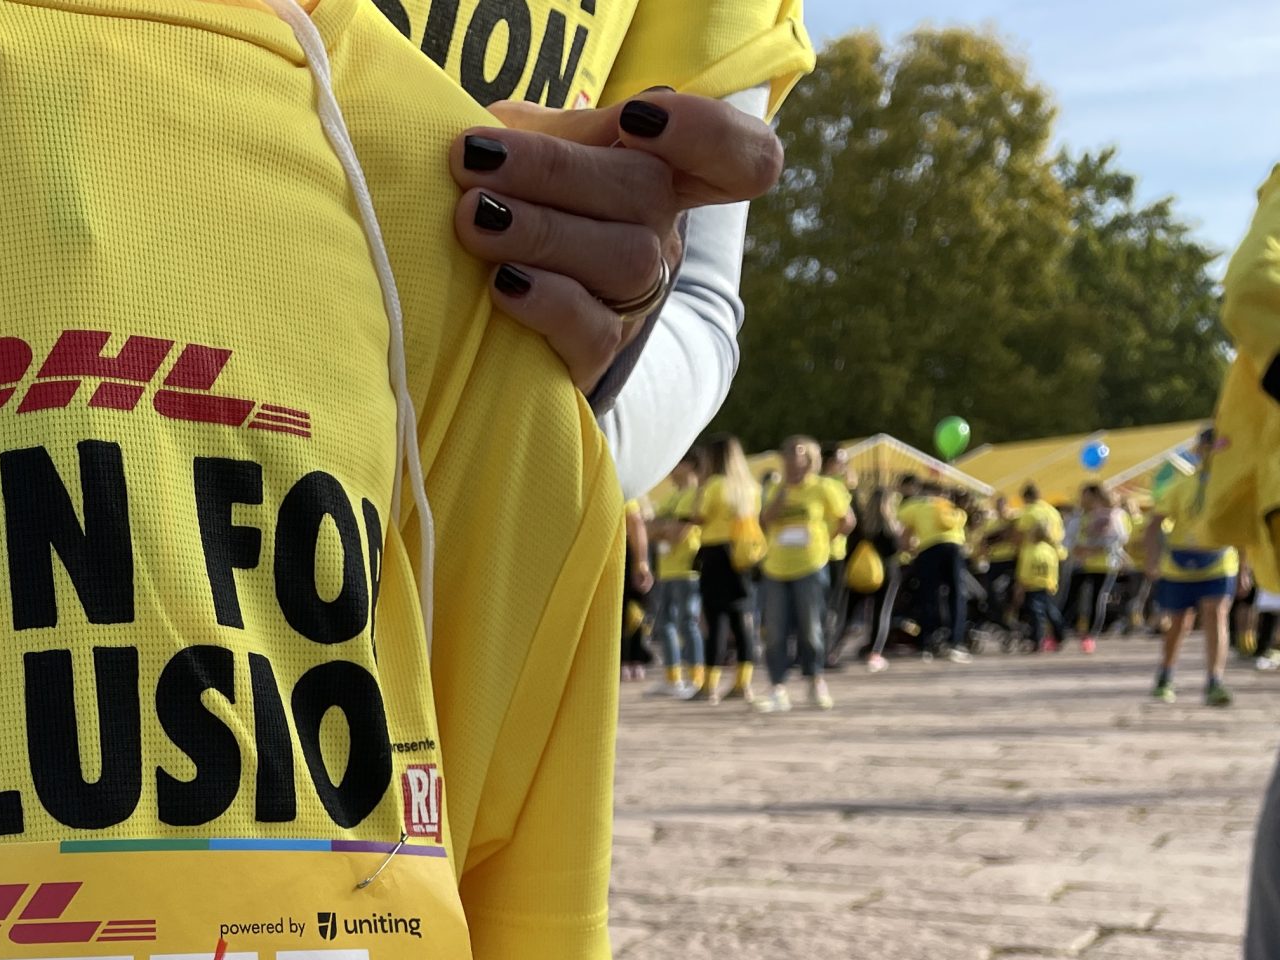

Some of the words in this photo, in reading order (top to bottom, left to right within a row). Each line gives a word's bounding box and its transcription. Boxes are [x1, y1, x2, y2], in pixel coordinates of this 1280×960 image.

[220, 917, 284, 939] powered
[289, 917, 306, 937] by
[344, 912, 422, 938] uniting
